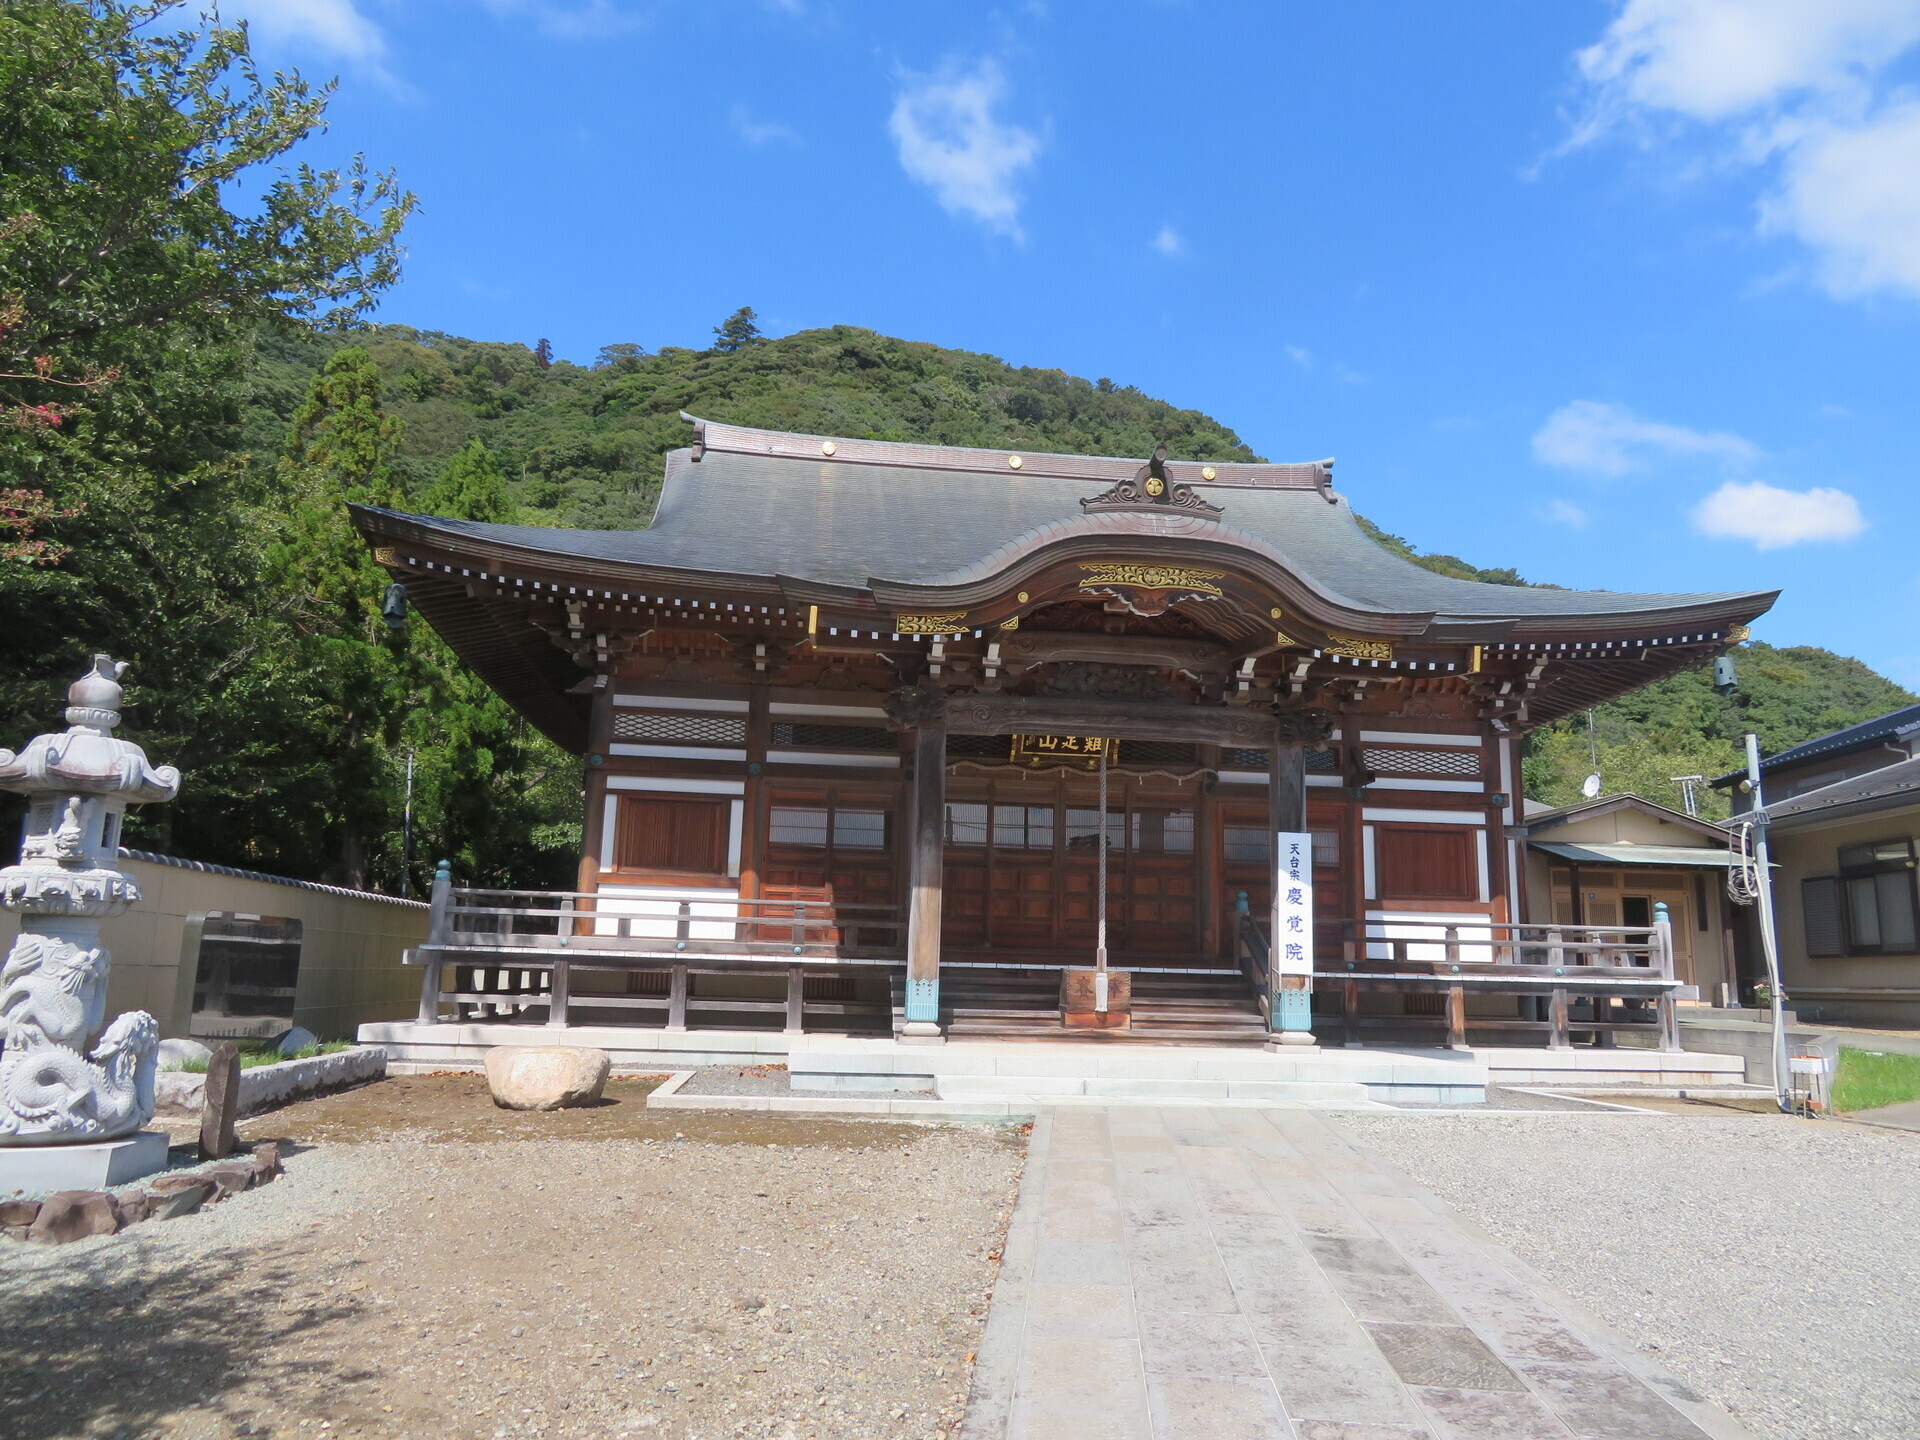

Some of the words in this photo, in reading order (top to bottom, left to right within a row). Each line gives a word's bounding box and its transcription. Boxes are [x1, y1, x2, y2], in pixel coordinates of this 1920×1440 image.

[1289, 843, 1300, 881] 天台宗
[1286, 887, 1304, 961] 慶覚院
